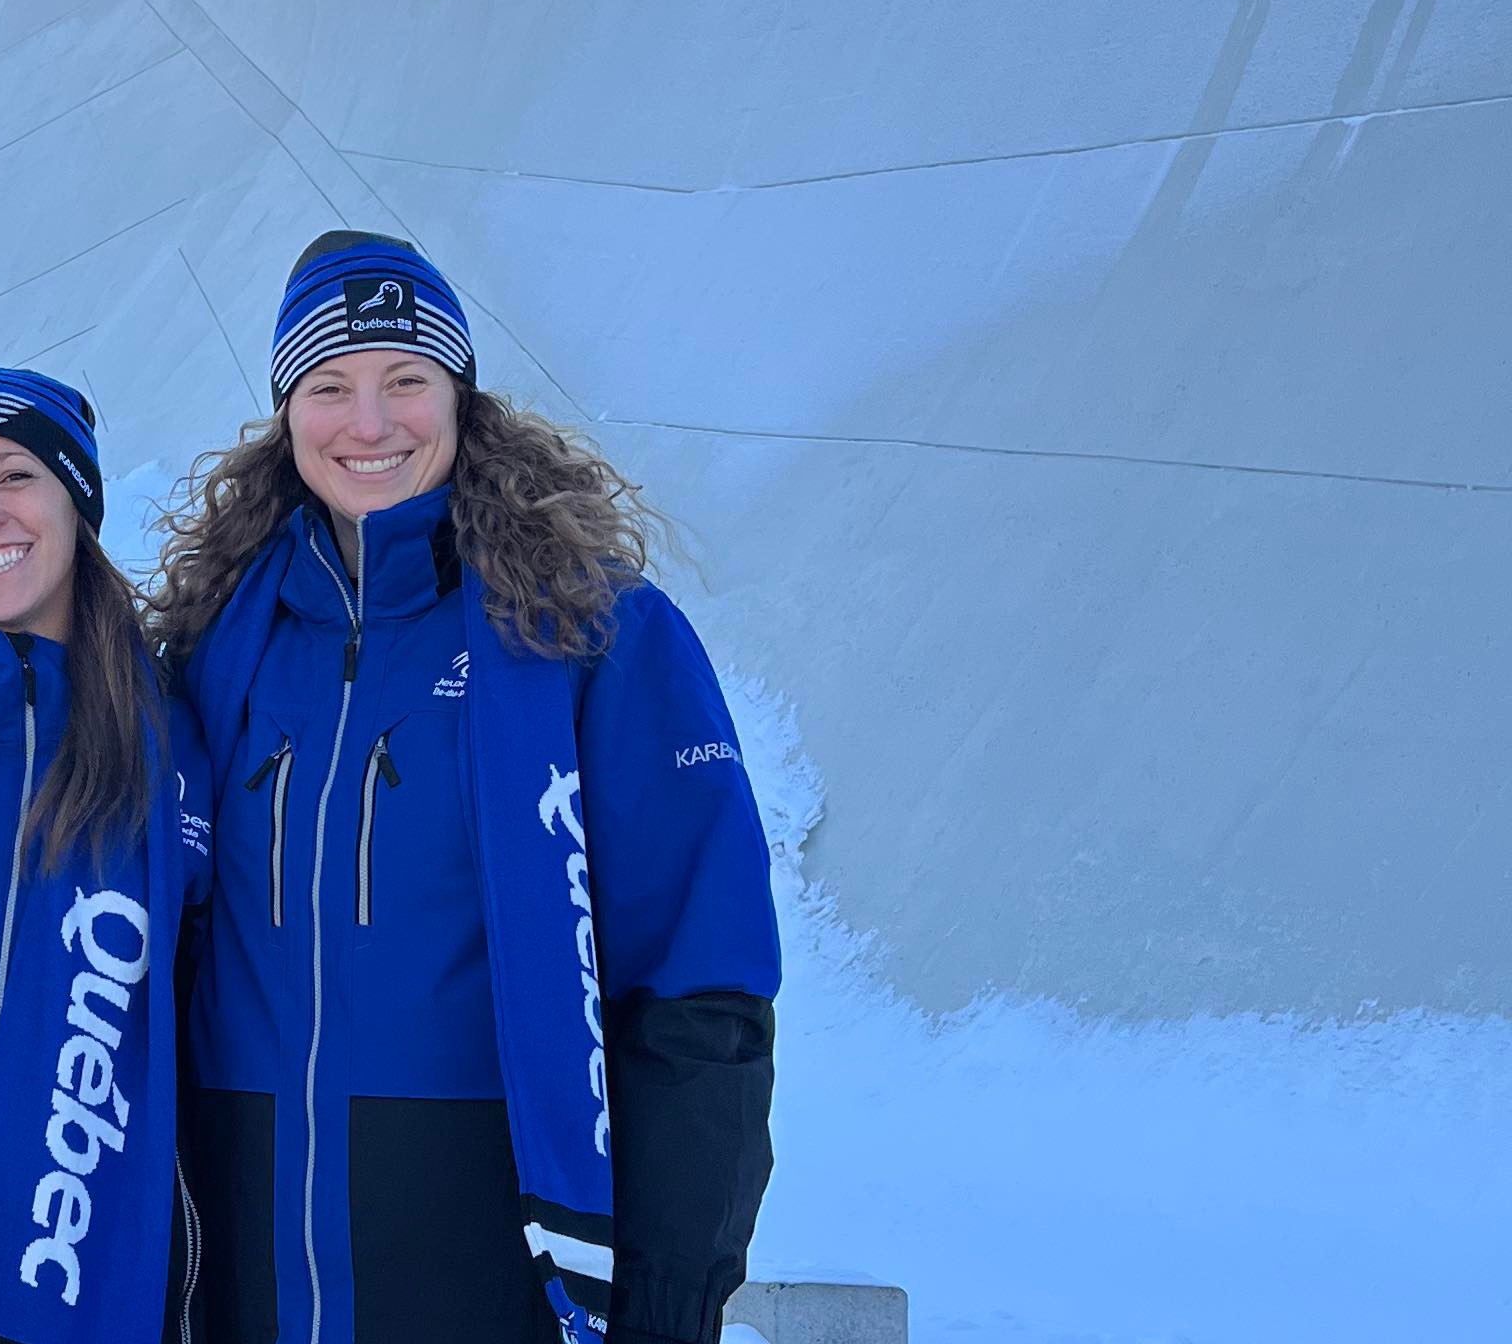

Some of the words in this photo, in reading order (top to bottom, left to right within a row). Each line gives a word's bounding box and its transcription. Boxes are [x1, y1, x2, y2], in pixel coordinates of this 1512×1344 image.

[351, 317, 396, 331] Québec
[59, 451, 93, 497] KARBON
[675, 742, 743, 768] KARB
[19, 886, 150, 1306] Québec
